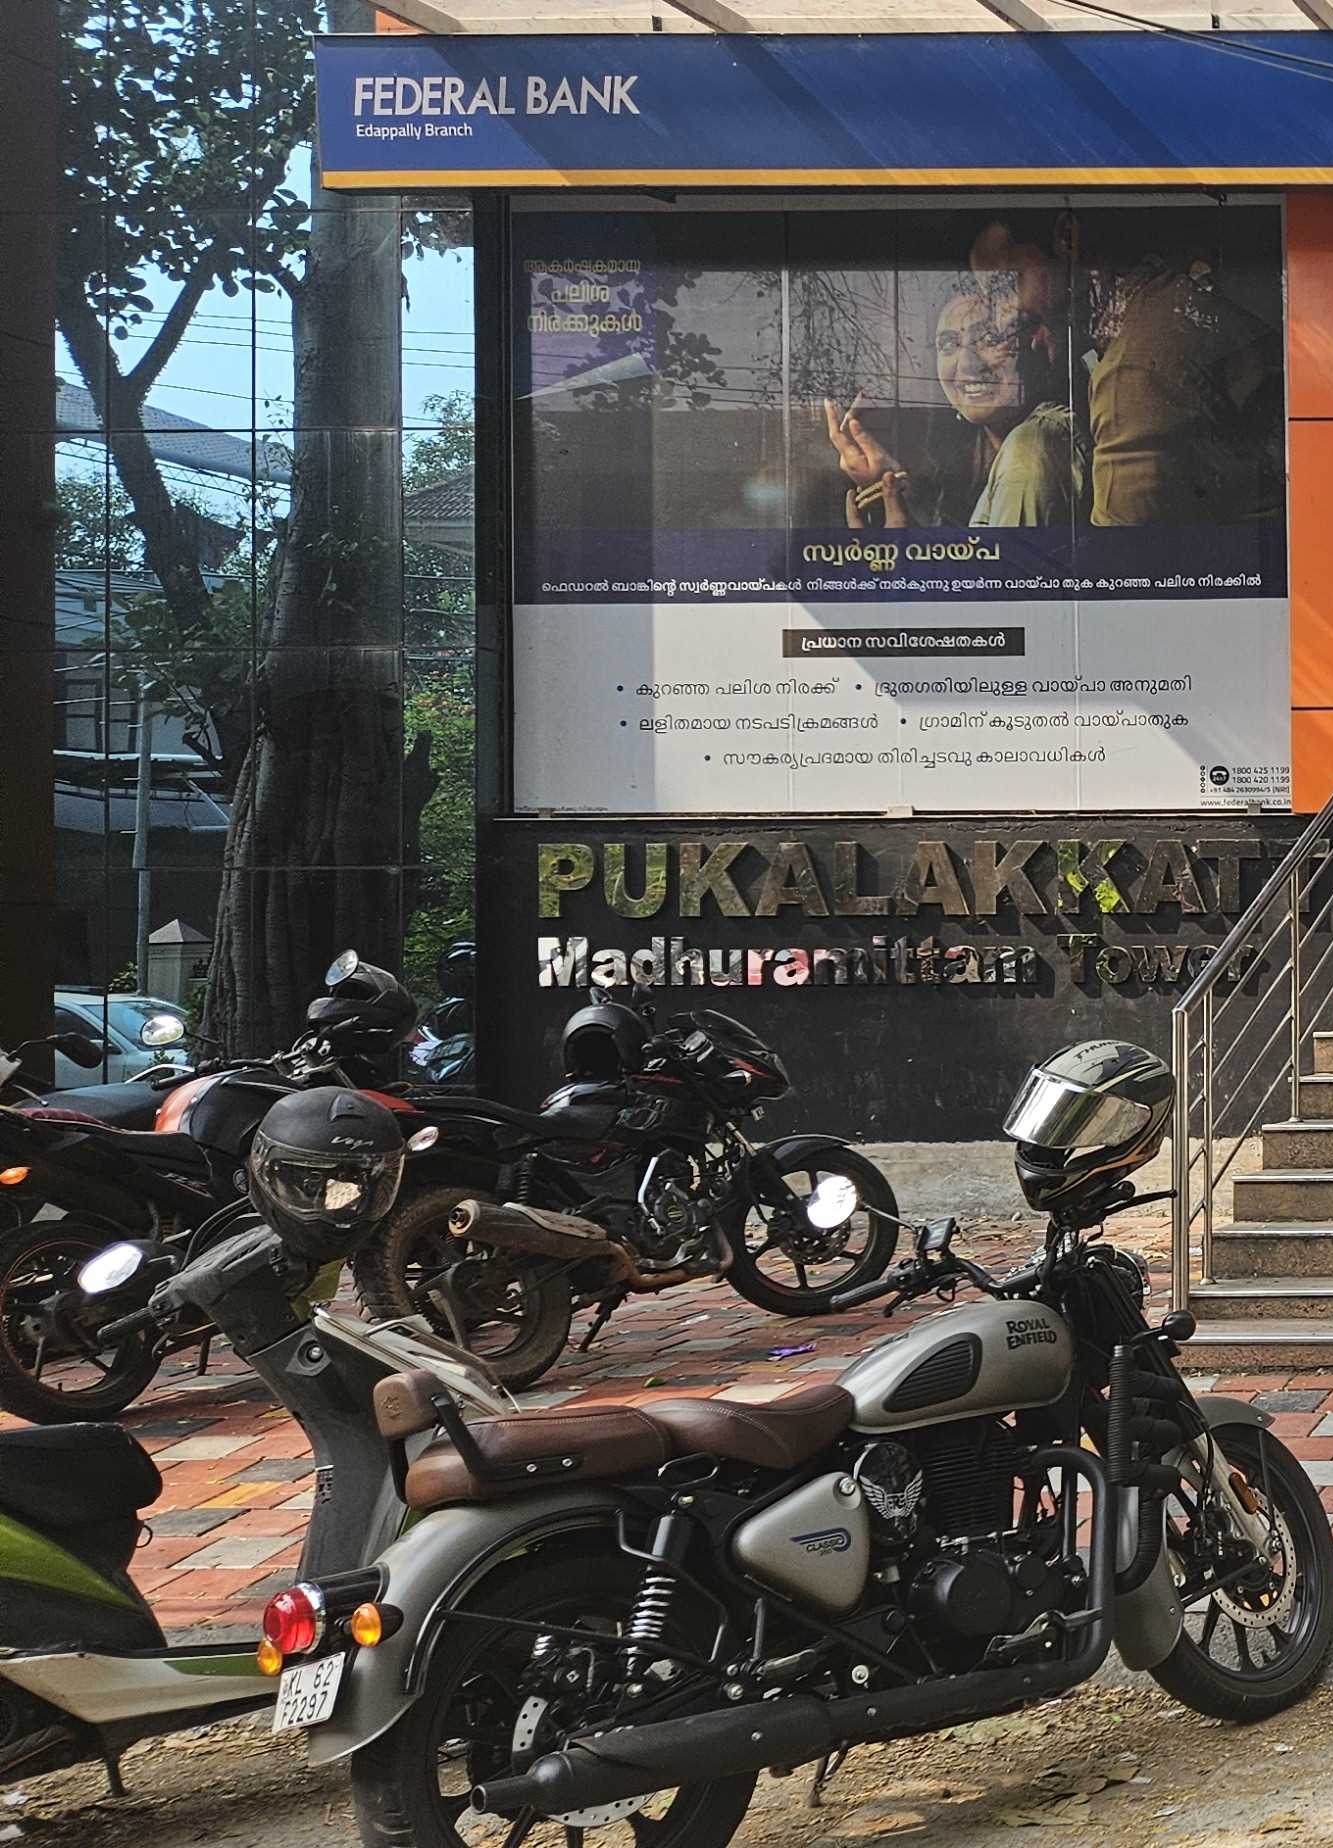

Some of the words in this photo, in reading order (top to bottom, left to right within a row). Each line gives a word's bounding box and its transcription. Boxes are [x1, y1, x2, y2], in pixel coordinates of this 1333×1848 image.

[354, 76, 515, 116] FEDERAL
[526, 75, 640, 115] BANK
[356, 123, 421, 140] Edappally
[425, 122, 473, 137] Branch
[715, 679, 772, 695] പലിശ
[537, 934, 1036, 988] Madhuramittam
[1006, 1318, 1050, 1334] ROYAL
[1006, 1330, 1057, 1350] ENFIELD
[289, 1669, 303, 1695] KL
[313, 1660, 334, 1689] 62
[281, 1690, 328, 1725] F2297
